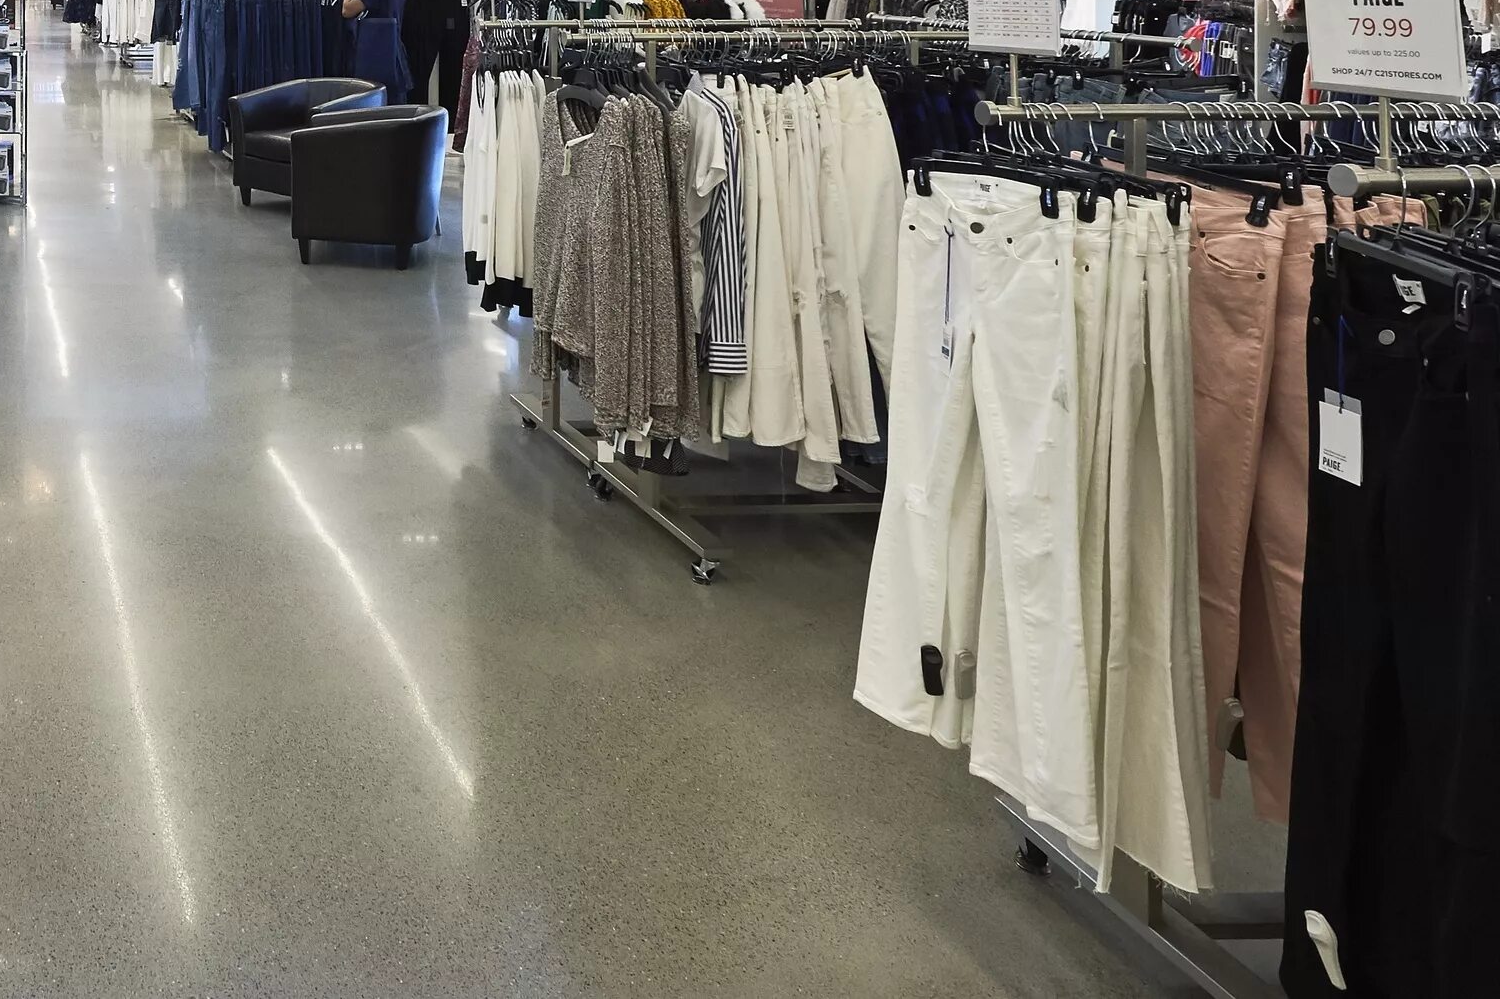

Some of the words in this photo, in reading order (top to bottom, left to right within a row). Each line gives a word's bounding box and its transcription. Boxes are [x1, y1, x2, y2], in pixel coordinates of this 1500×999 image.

[1348, 18, 1413, 37] 79.99
[1393, 50, 1420, 58] 225.00
[1332, 67, 1353, 75] SHOP
[1355, 68, 1372, 77] 24/7
[1374, 70, 1442, 80] C21STORES.COM
[1322, 456, 1342, 472] PAIGE
